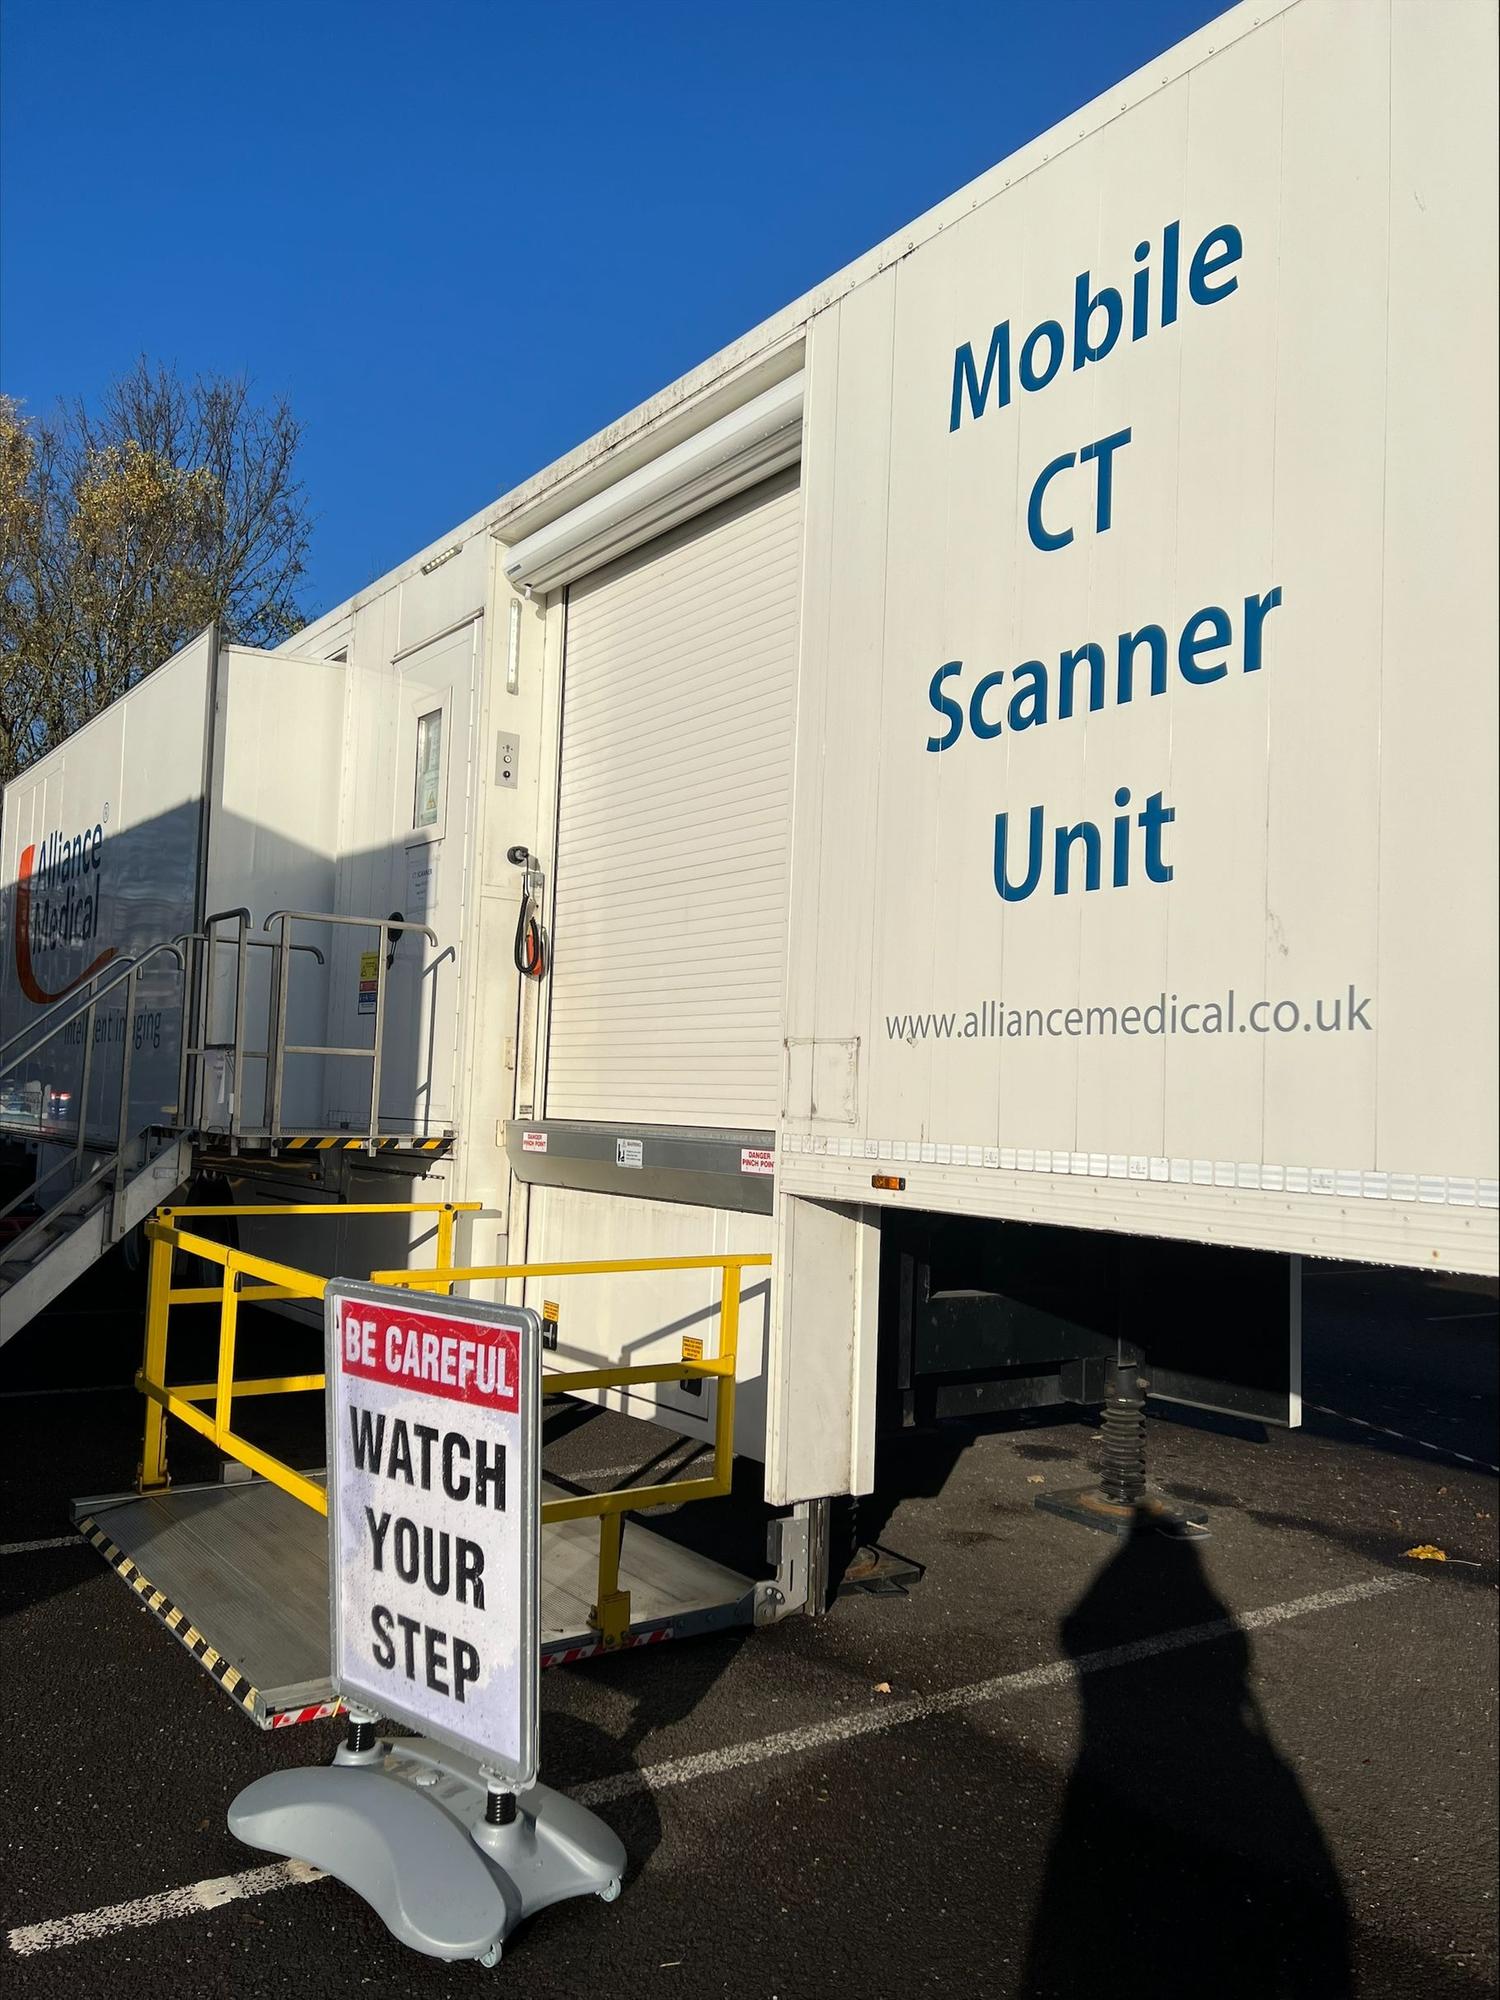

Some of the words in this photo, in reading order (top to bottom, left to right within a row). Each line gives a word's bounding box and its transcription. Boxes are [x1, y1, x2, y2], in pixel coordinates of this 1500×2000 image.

[949, 219, 1243, 433] Mobile
[1027, 426, 1132, 552] CT
[926, 586, 1282, 753] Scanner
[35, 824, 103, 895] Alliance
[993, 787, 1176, 902] Unit
[32, 873, 101, 955] Medical
[886, 984, 1373, 1040] www.alliancemedical.co.uk
[742, 1158, 759, 1167] PINCH
[748, 1151, 771, 1160] DANGER
[345, 1317, 377, 1368] BE
[385, 1325, 515, 1398] CAREFUL
[349, 1405, 508, 1513] WATCH
[365, 1506, 486, 1612] YOUR
[371, 1604, 481, 1704] STEP
